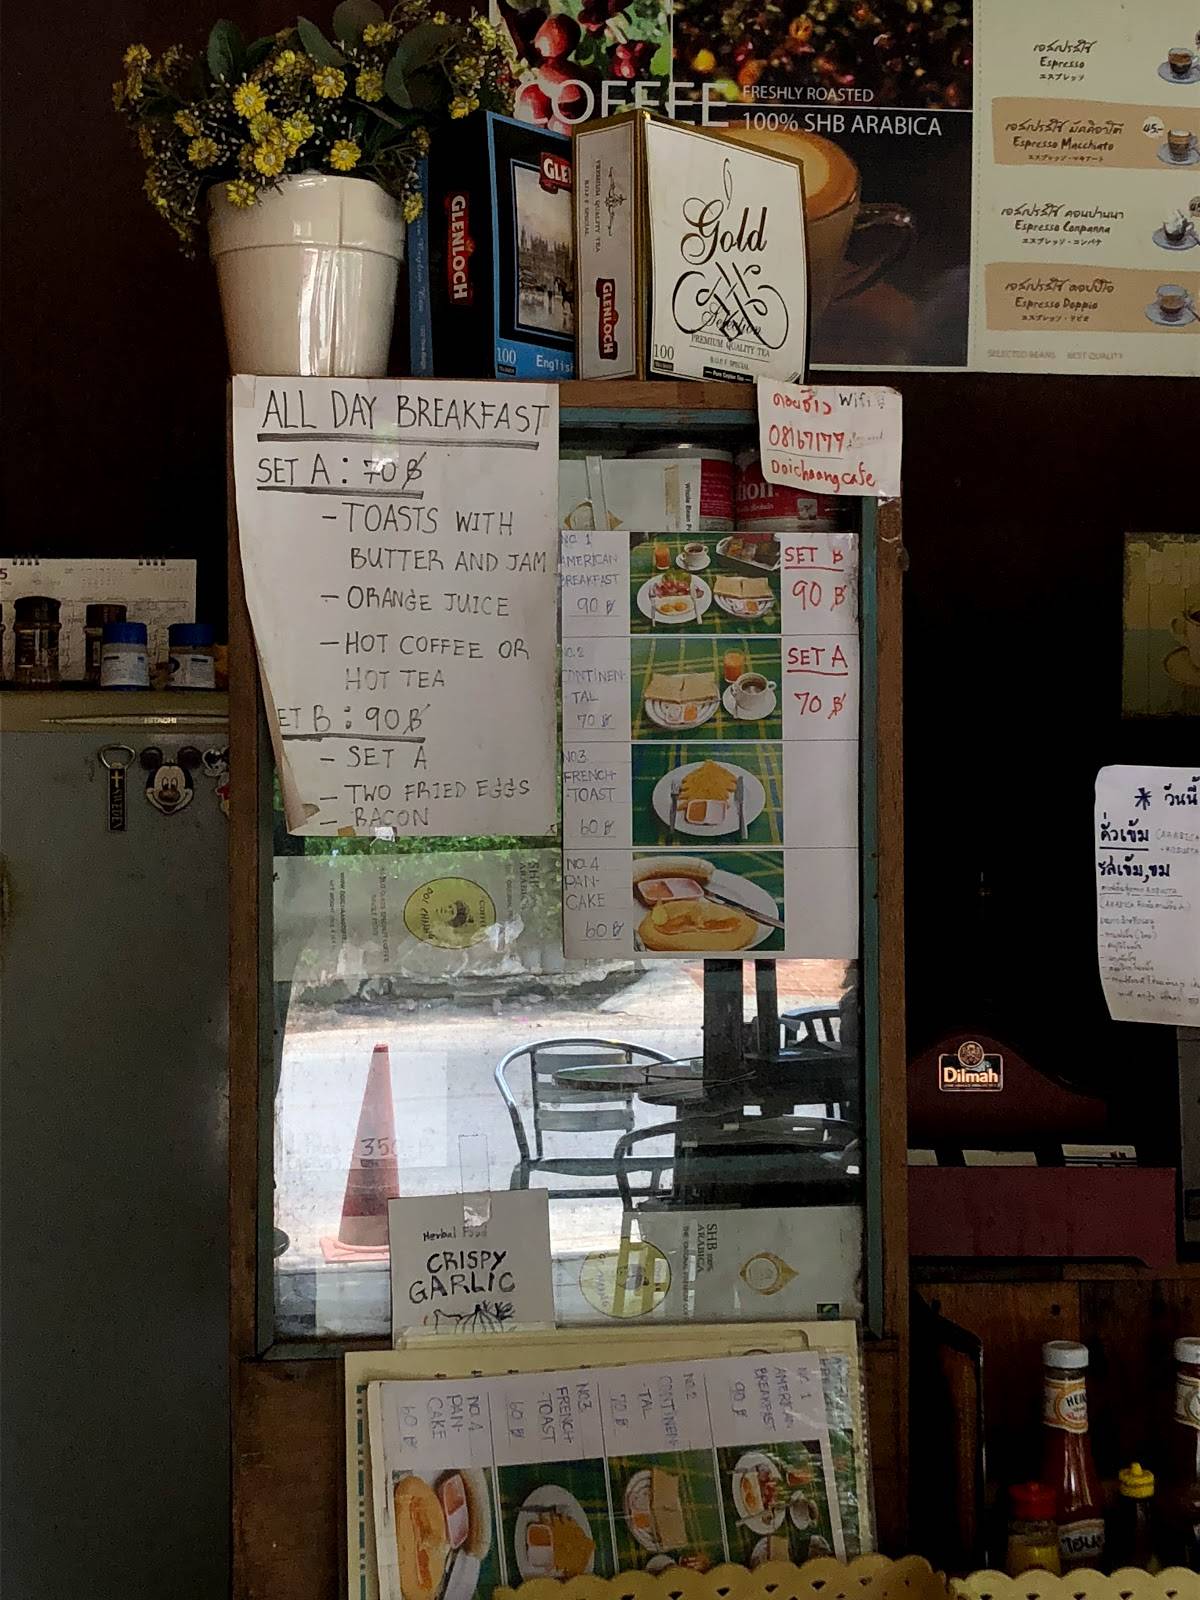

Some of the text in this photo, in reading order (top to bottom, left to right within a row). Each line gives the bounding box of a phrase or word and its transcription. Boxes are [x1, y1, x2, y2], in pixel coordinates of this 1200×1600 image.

[1040, 56, 1085, 70] Espresso
[516, 79, 729, 128] COFFEE
[743, 85, 874, 103] FRESHLY ROASTED
[742, 112, 942, 136] 100% SHB ARABICA
[1013, 136, 1114, 151] Espresso Macchiato
[680, 197, 768, 266] Gold
[1015, 219, 1060, 233] Espresso
[451, 195, 468, 300] GLENLOCH
[1015, 297, 1098, 312] Espresso Doppio
[601, 281, 615, 354] GLENLOCH
[496, 346, 517, 365] 100
[653, 344, 675, 361] 100
[691, 332, 770, 358] PREMIUM QUALITY TEA
[262, 390, 551, 436] ALL DAY BREAKFAST
[256, 456, 299, 486] SET
[342, 502, 513, 537] TOASTS WITH
[350, 546, 547, 573] BUTTER AND JAM
[784, 546, 844, 564] SET B
[347, 584, 511, 618] ORANGE JUICE
[576, 597, 598, 614] 90
[791, 579, 822, 611] 90
[344, 630, 530, 661] HOT COFFEE OR
[787, 644, 849, 669] SET A
[345, 667, 445, 691] HOT TEA
[794, 691, 822, 716] 70
[576, 713, 596, 729] 70
[347, 745, 428, 770] SET A
[344, 779, 530, 802] TWO FRIED EGGS
[353, 804, 430, 829] BACON
[579, 818, 599, 836] 60
[565, 893, 606, 911] CAKE
[585, 920, 608, 939] 60
[943, 1066, 999, 1083] Dilmah
[423, 1226, 457, 1242] Herbal
[706, 1223, 719, 1251] SHB
[696, 1223, 706, 1274] ARABICA
[426, 1250, 507, 1274] CRISPY
[408, 1271, 516, 1304] GARLIC
[731, 1381, 747, 1402] 90
[425, 1395, 447, 1441] CAKE
